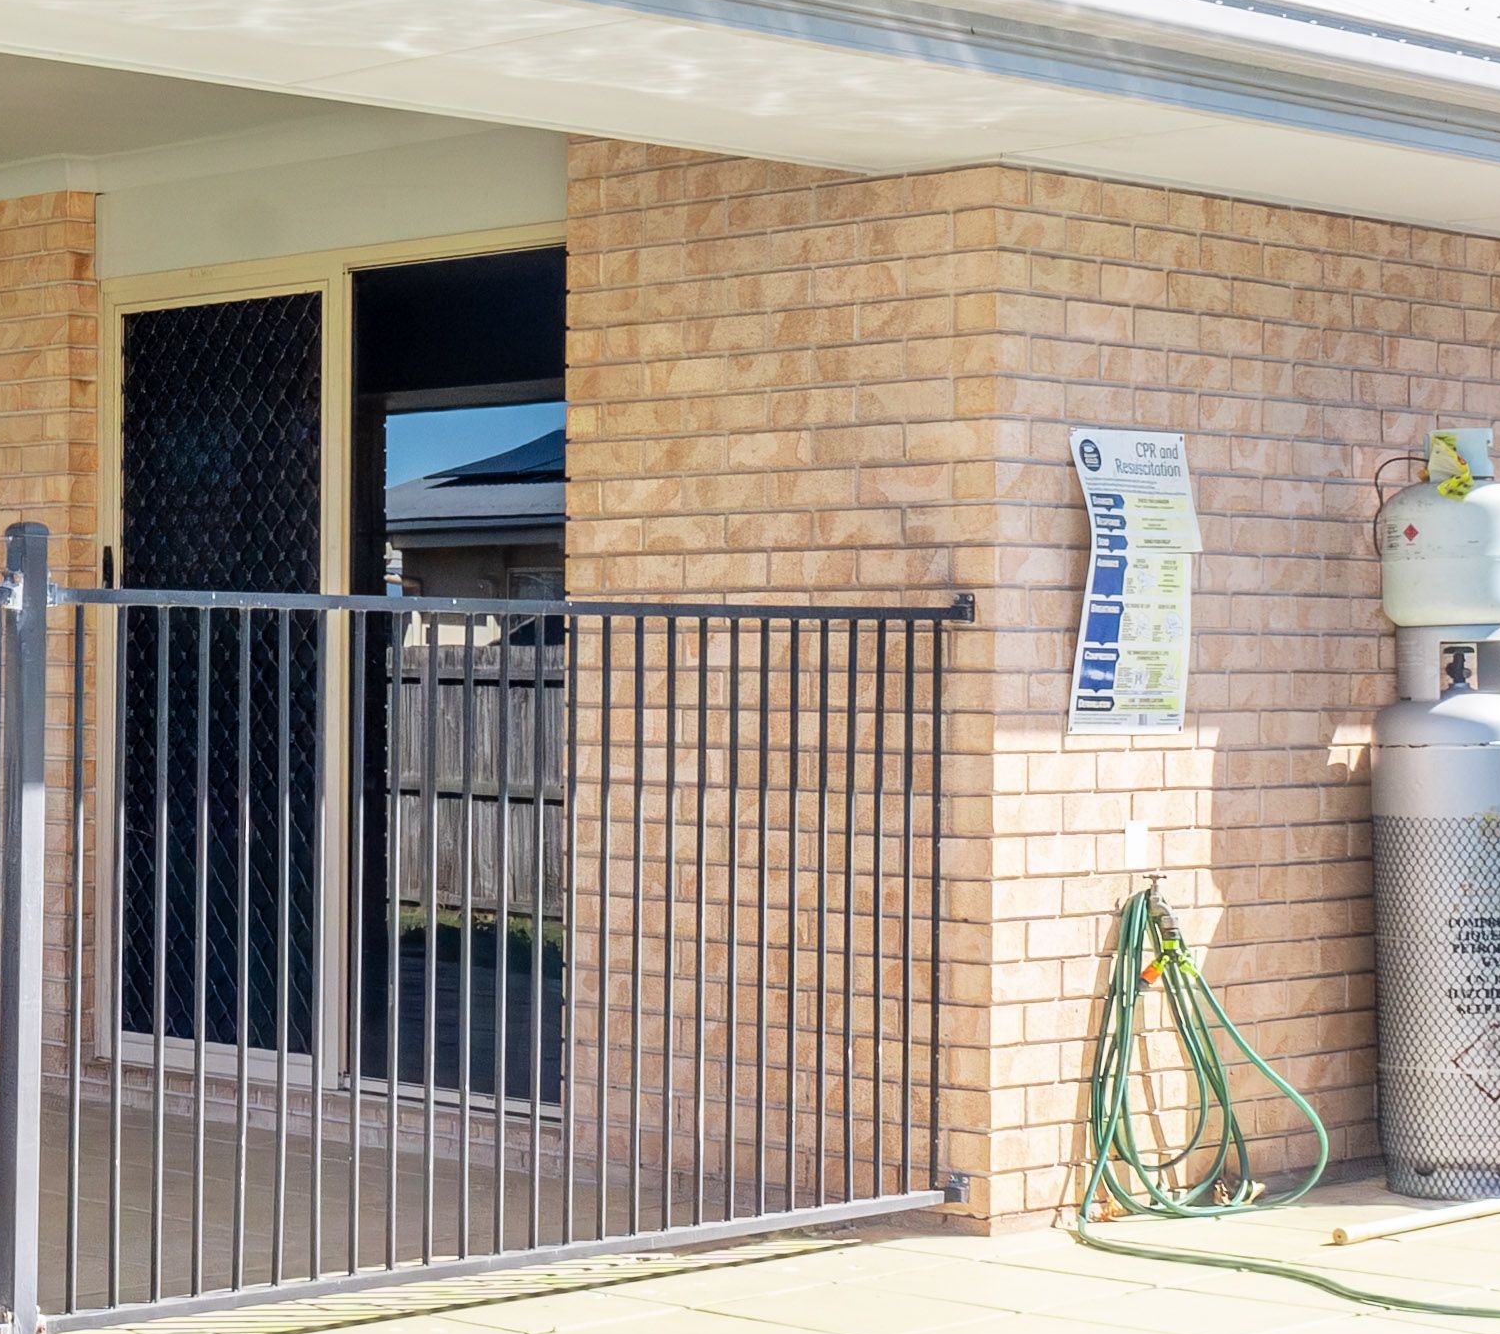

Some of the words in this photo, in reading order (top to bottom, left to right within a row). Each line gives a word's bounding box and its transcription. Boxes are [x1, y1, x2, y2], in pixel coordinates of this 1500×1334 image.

[1135, 442, 1157, 458] CPR
[1159, 444, 1179, 459] and
[1115, 458, 1181, 477] Resuscitation
